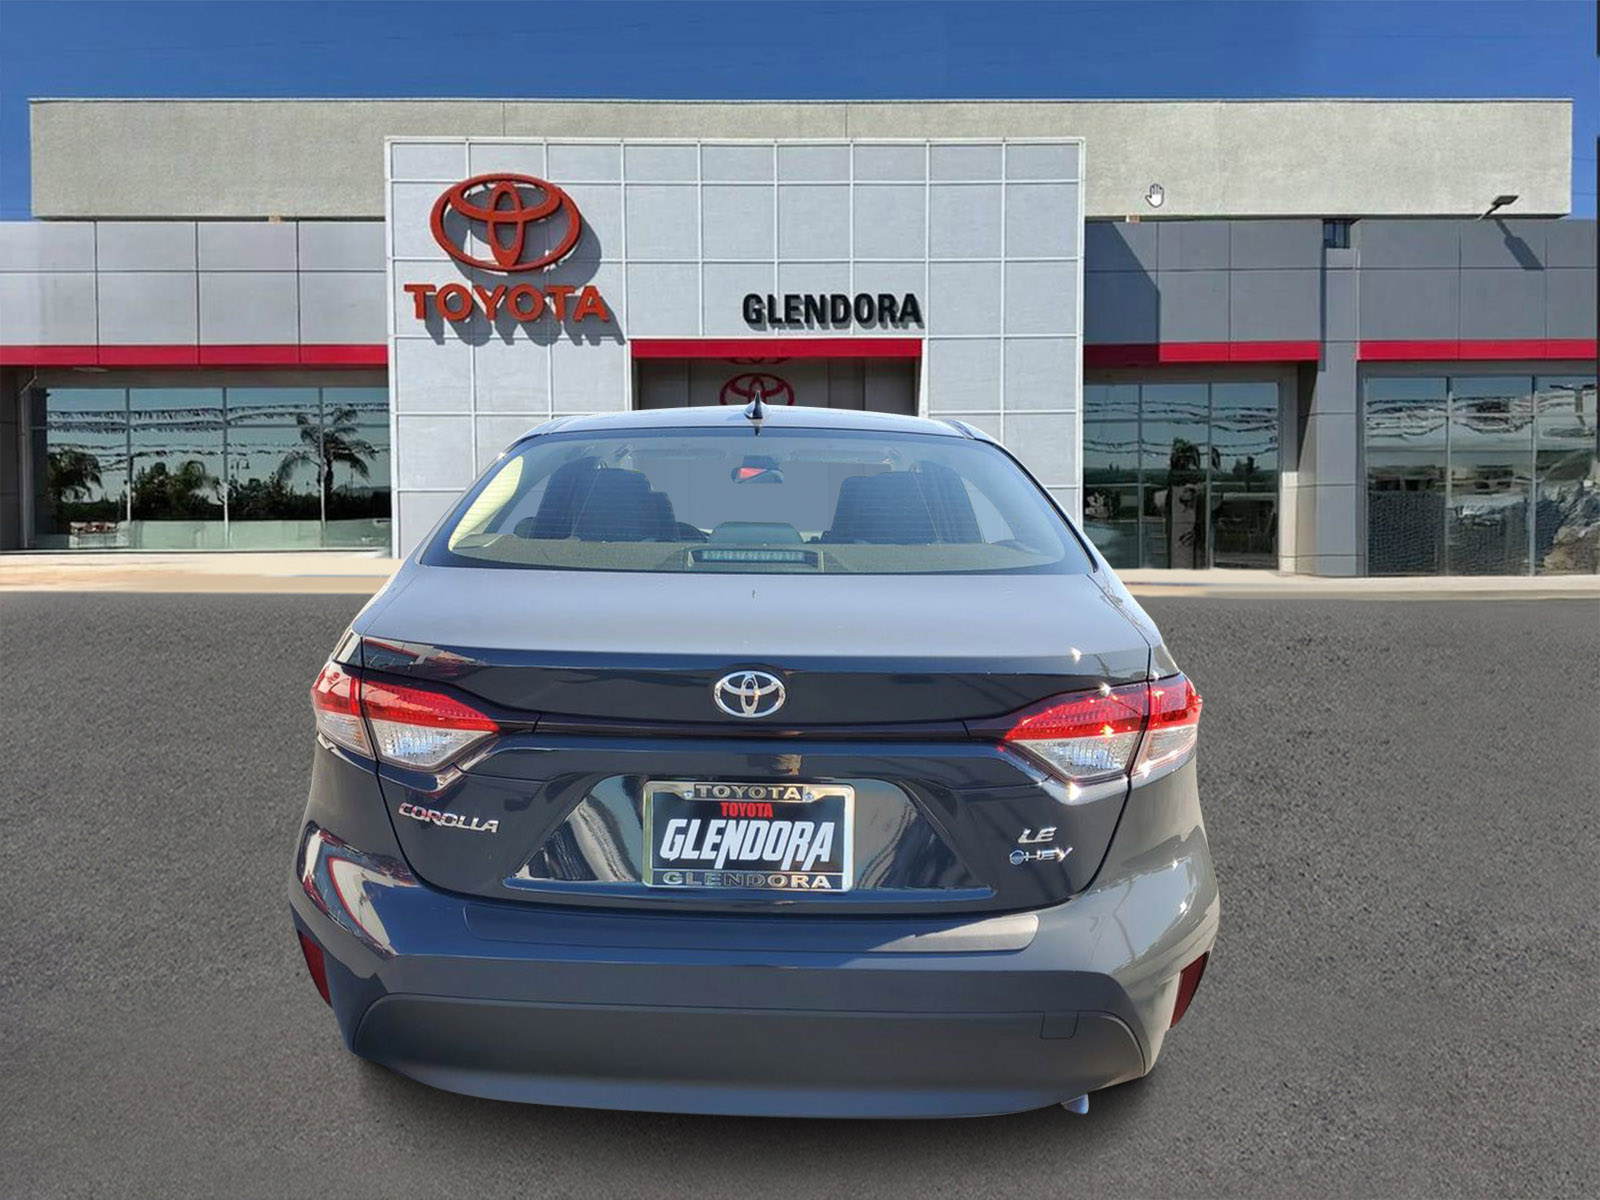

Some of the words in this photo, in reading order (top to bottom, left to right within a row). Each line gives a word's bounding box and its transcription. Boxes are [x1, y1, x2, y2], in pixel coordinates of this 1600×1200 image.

[404, 283, 611, 323] TOYOTA
[742, 293, 922, 326] GLENDORA
[695, 784, 803, 800] TOYOTA
[398, 802, 500, 834] COROLLA
[720, 802, 773, 817] TOYOTA
[660, 818, 835, 871] GLENDORA
[1017, 826, 1057, 844] LE
[662, 871, 832, 889] GLENDORA
